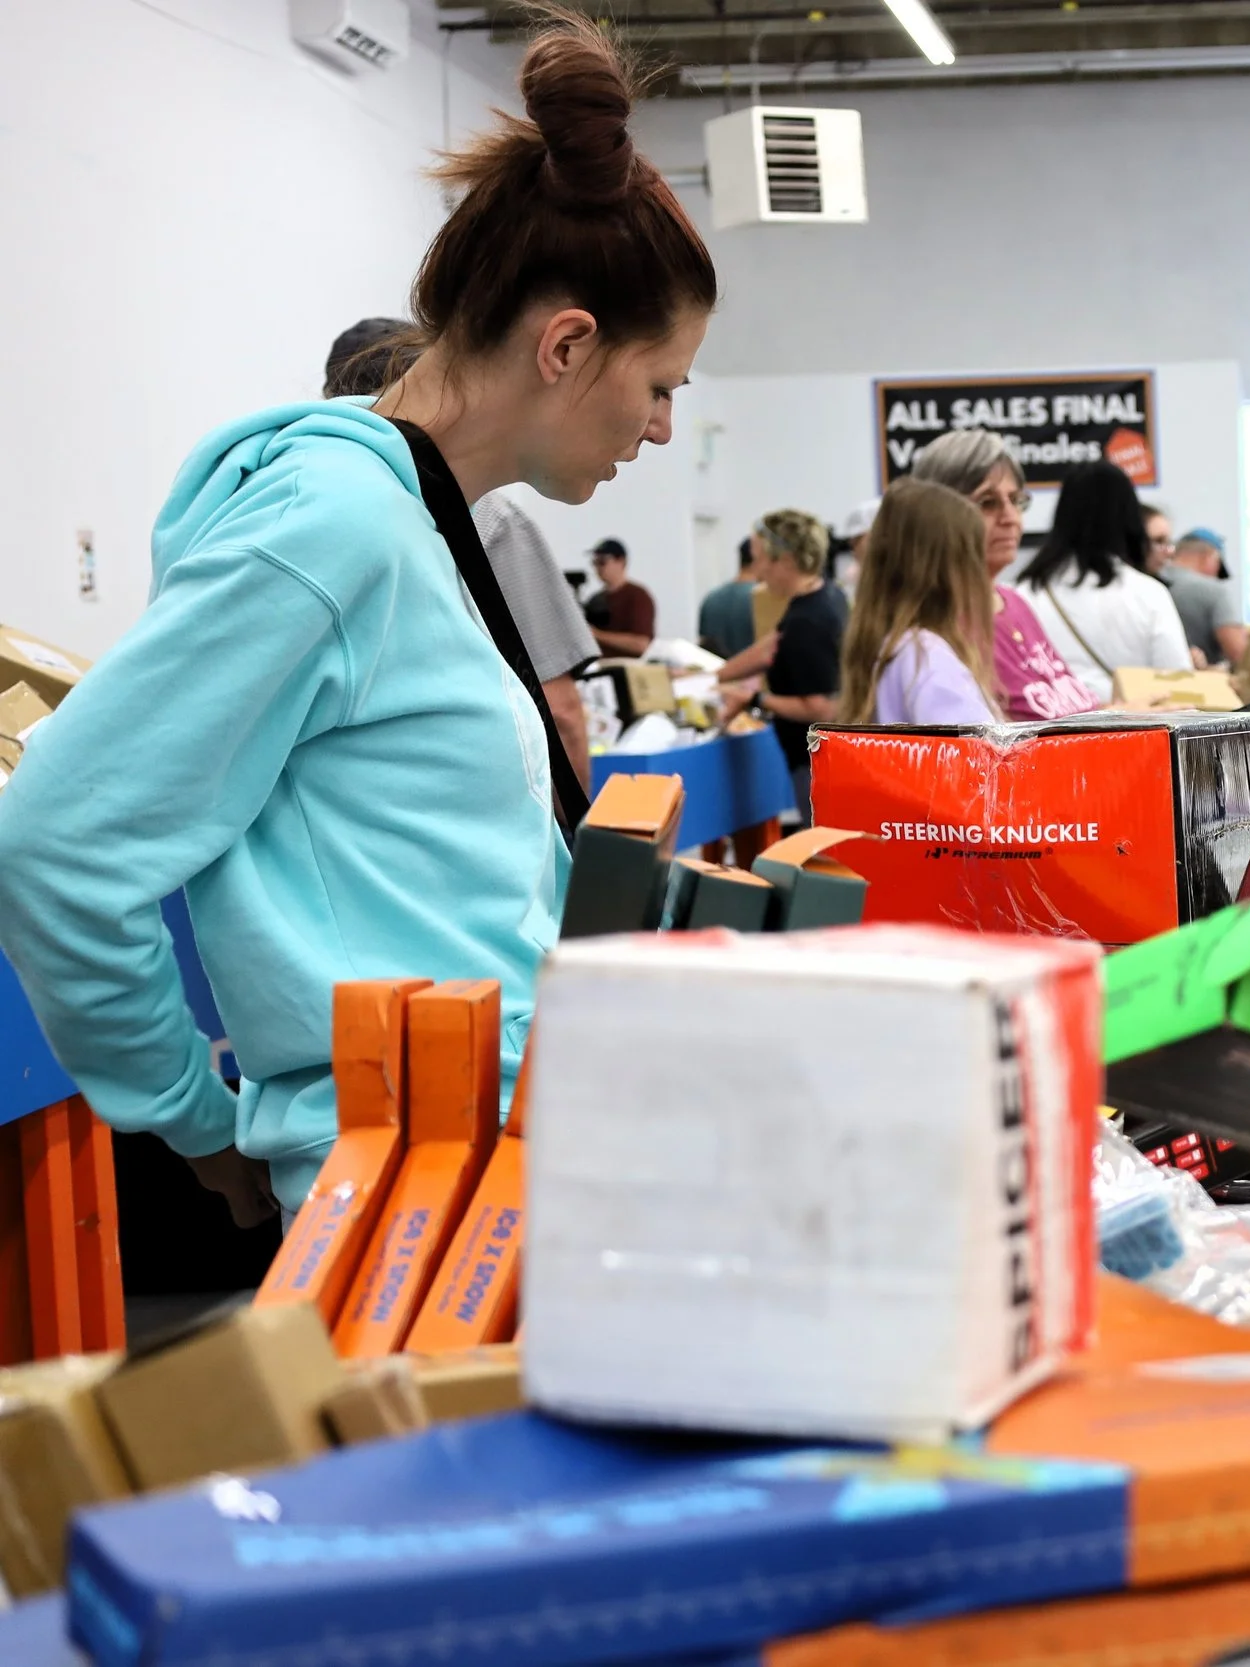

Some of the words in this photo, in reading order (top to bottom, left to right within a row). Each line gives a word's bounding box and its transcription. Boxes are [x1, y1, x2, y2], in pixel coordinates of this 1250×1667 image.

[887, 401, 945, 431] ALL
[950, 396, 1049, 429] SALES
[1053, 394, 1145, 425] FINAL
[880, 822, 983, 844] STEERING
[990, 822, 1099, 844] KNUCKLE
[952, 849, 1042, 860] A-PREMIUM
